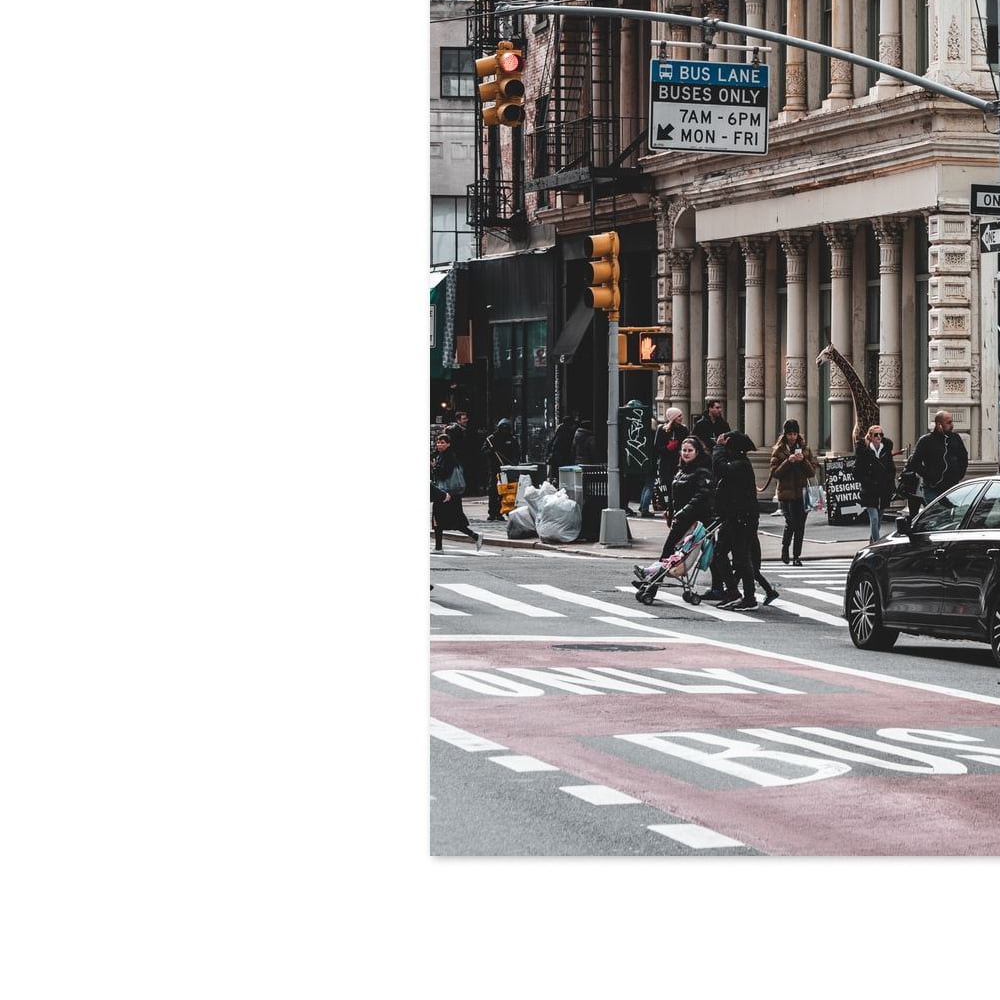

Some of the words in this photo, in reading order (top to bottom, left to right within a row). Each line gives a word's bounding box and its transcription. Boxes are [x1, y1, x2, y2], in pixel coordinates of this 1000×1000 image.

[680, 66, 711, 81] BUS
[718, 68, 760, 83] LANE
[659, 85, 712, 101] BUSES
[719, 88, 760, 104] ONLY
[680, 109, 712, 124] 7AM
[728, 112, 761, 127] 6PM
[681, 129, 715, 144] MON
[734, 131, 758, 146] FRI
[985, 231, 996, 245] ONE
[431, 667, 807, 696] ONLY
